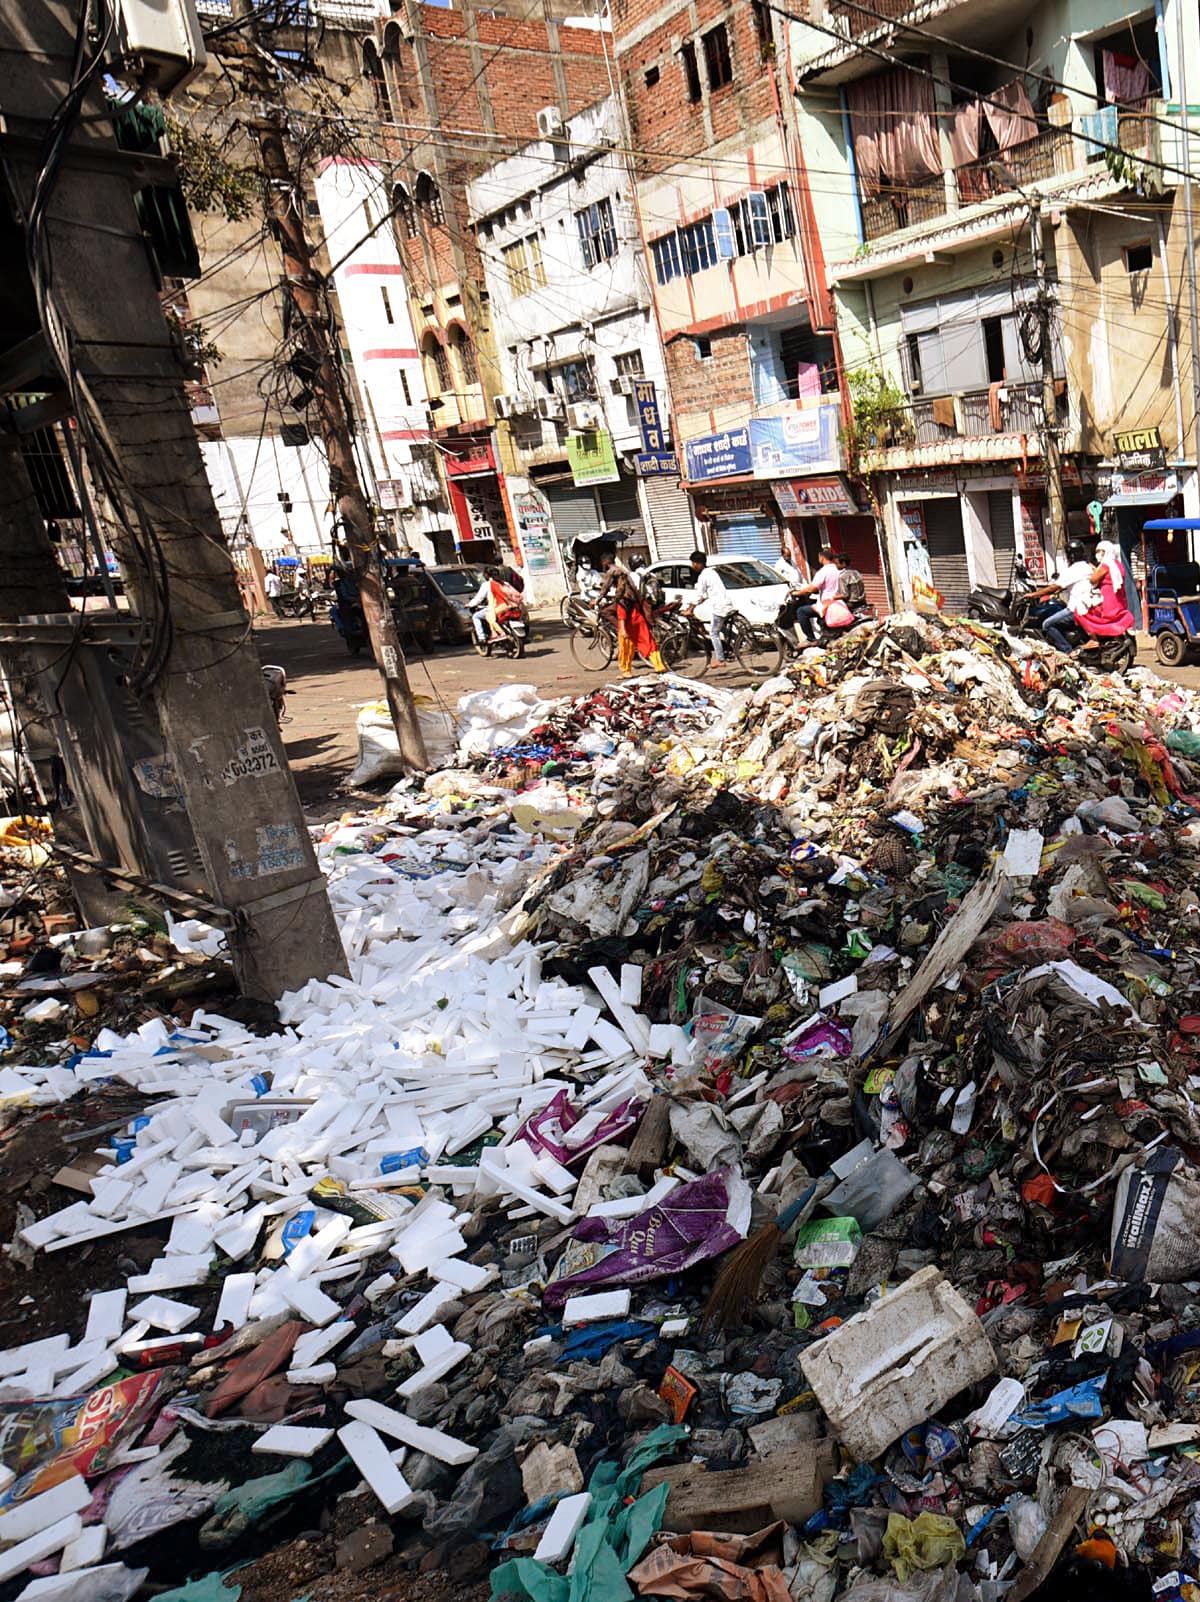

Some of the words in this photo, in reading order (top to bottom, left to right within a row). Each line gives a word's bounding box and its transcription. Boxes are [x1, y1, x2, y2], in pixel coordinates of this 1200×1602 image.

[1115, 428, 1160, 452] ताला
[641, 456, 659, 473] शादी
[807, 484, 846, 502] EXIDE
